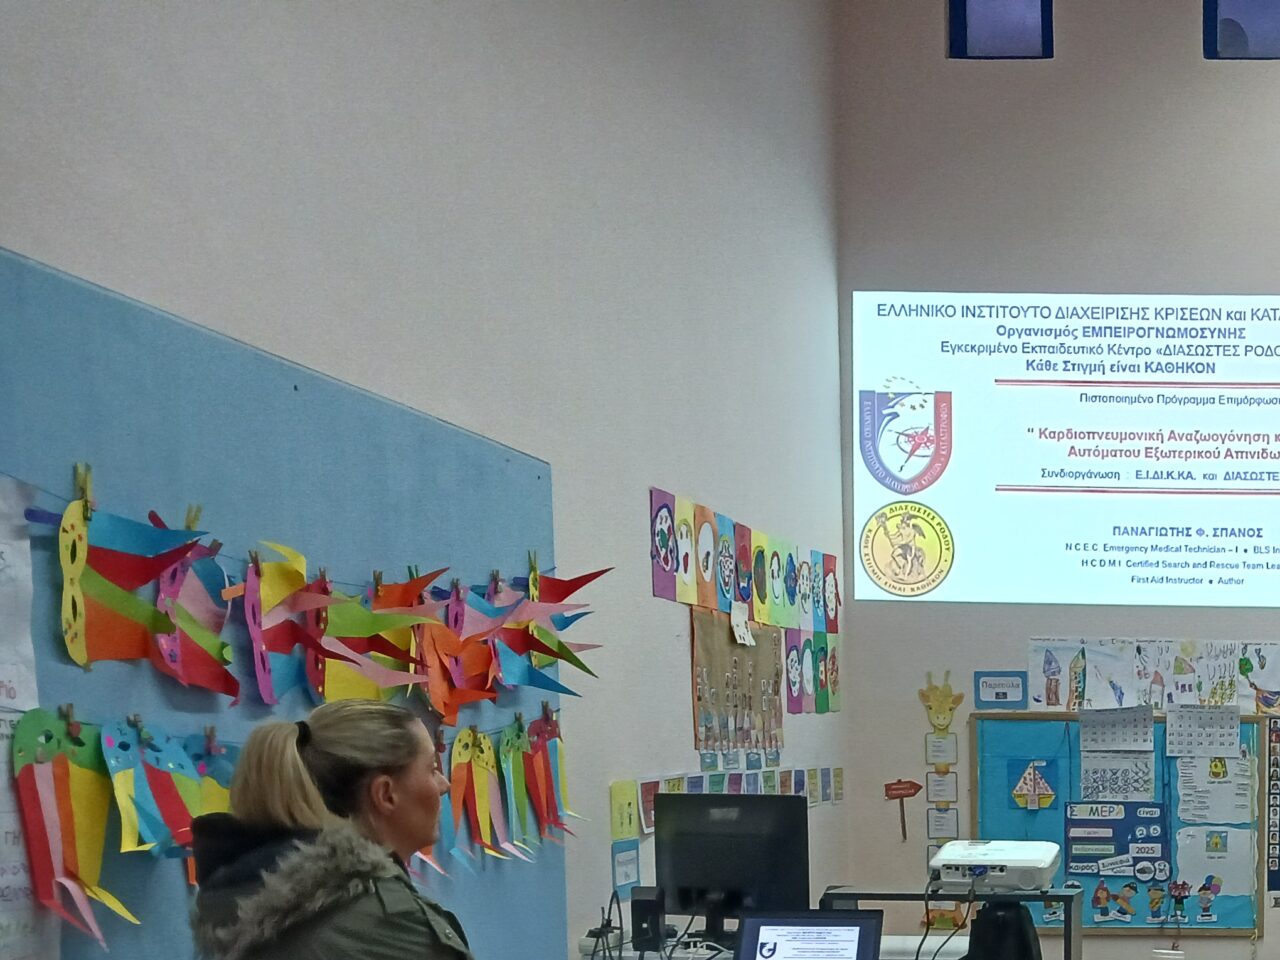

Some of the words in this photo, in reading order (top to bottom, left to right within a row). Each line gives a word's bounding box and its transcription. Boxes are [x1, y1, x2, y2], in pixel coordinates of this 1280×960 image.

[877, 304, 956, 318] ΕΛΛΗΝΙΚΟ
[961, 305, 1051, 319] ΙΝΣΤΙΤΟΥΤΟ
[1055, 306, 1150, 320] ΔΙΑΧΕΙΡΙΣΗΣ
[1155, 307, 1222, 321] ΚΡΙΣΕΩΝ
[1226, 310, 1246, 321] και
[996, 325, 1078, 340] Οργανισμός
[1082, 326, 1246, 339] ΕΜΠΕΙΡΟΓΝΩΜΟΣΥΝΗΣ
[941, 341, 1018, 356] Εγκεκριμένο
[1022, 342, 1104, 355] Εκπαιδευτικό
[1107, 344, 1151, 358] Κέντρο
[1156, 344, 1240, 357] «ΔΙΑΣΩΣΤΕΣ
[1026, 359, 1058, 372] Κάθε
[1062, 360, 1105, 375] Στιγμή
[1110, 360, 1140, 373] είναι
[1145, 361, 1215, 374] ΚΑΘΗΚΟΝ
[1080, 393, 1154, 405] Πιστοποιημένο
[1157, 394, 1215, 406] Πρόγραμμα
[1039, 427, 1164, 443] Καρδιοπνευμονική
[1167, 429, 1270, 445] Αναζωογόνηση
[1068, 445, 1141, 460] Αυτόματου
[1144, 447, 1220, 462] Εξωτερικού
[1041, 468, 1120, 481] Συνδιοργάνωση
[1113, 526, 1192, 537] ΠΑΝΑΓΙΩΤΗΣ
[1196, 528, 1209, 537] Φ.
[1212, 528, 1263, 538] ΣΠΑΝΟΣ
[1103, 543, 1148, 554] Emergency
[1151, 544, 1182, 552] Medical
[1184, 545, 1226, 553] Technician
[1253, 546, 1270, 554] BLS
[1126, 560, 1159, 568] Certified
[1162, 560, 1190, 568] Search
[1209, 561, 1239, 569] Rescue
[1242, 561, 1264, 569] Team
[1131, 575, 1149, 583] First
[1150, 576, 1164, 584] Aid
[1166, 576, 1203, 584] Instructor
[1135, 847, 1155, 855] 2025
